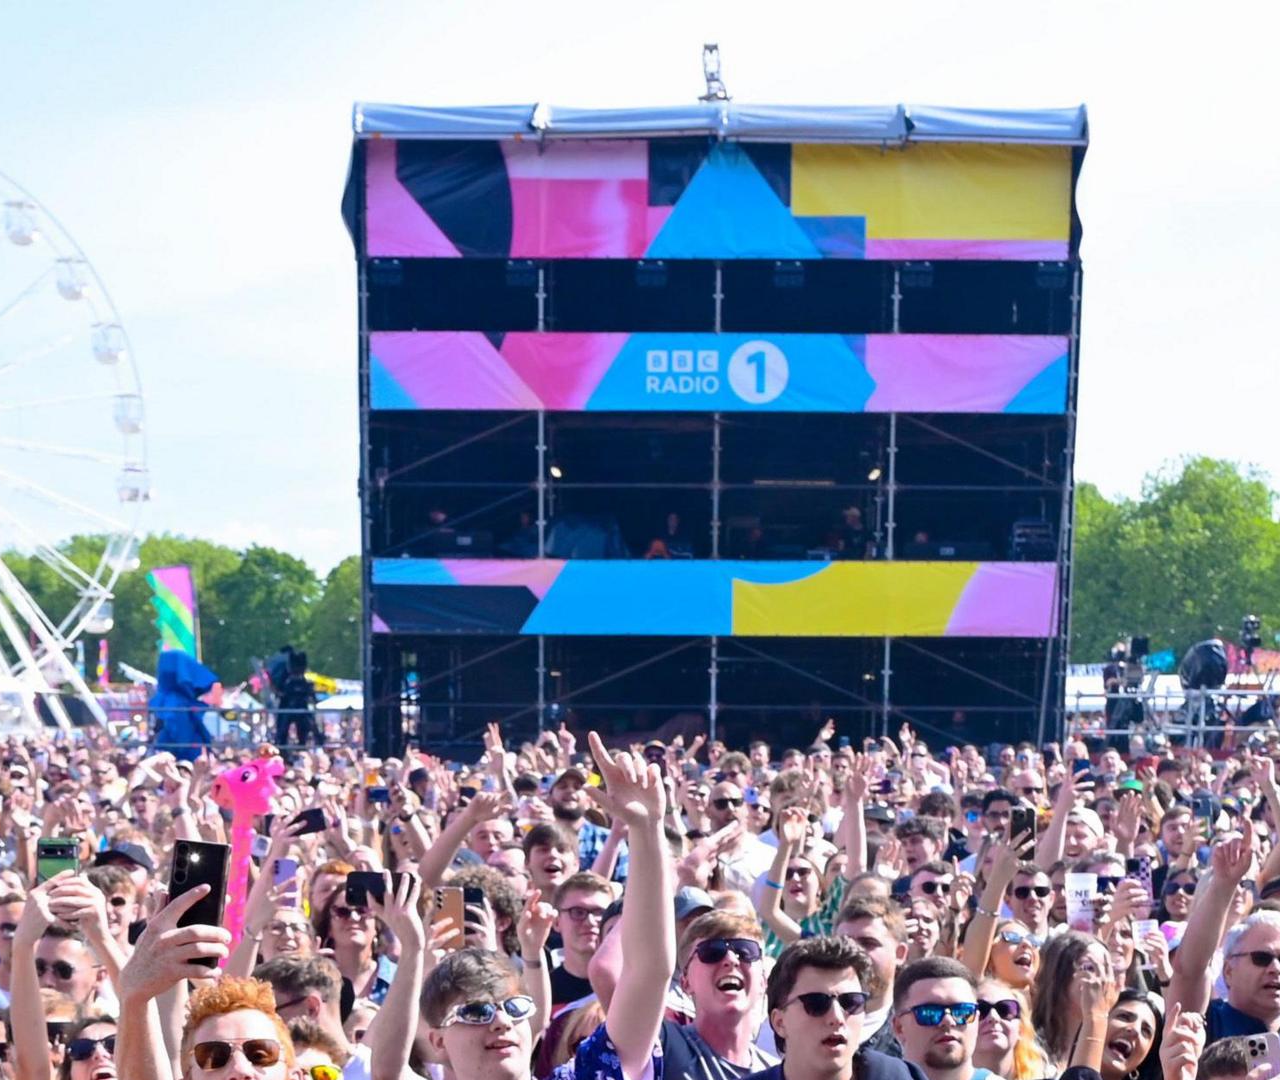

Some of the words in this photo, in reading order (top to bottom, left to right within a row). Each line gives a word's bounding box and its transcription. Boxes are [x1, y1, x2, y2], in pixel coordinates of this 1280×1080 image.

[646, 376, 719, 394] RADIO
[747, 351, 766, 394] 1
[648, 351, 718, 372] BBC
